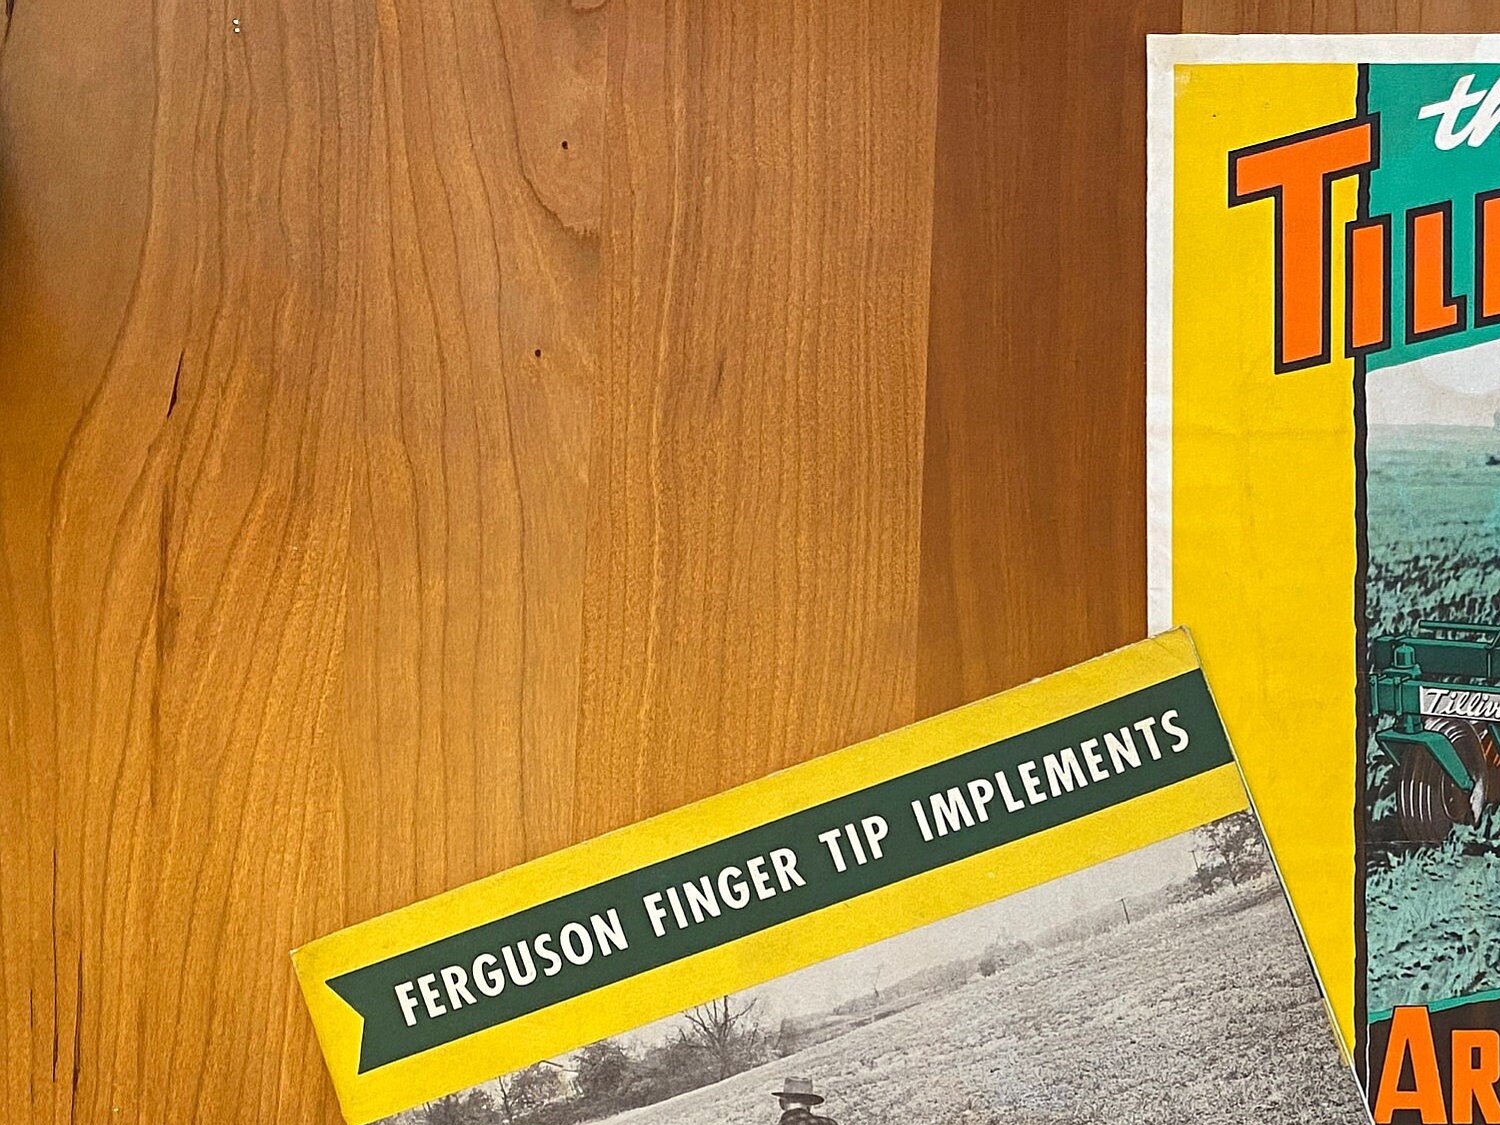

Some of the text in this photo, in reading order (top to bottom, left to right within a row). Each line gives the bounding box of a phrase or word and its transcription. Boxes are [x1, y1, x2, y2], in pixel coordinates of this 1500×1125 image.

[394, 710, 1191, 1028] FERGUSON FINGER TIP IMPLEMENTS
